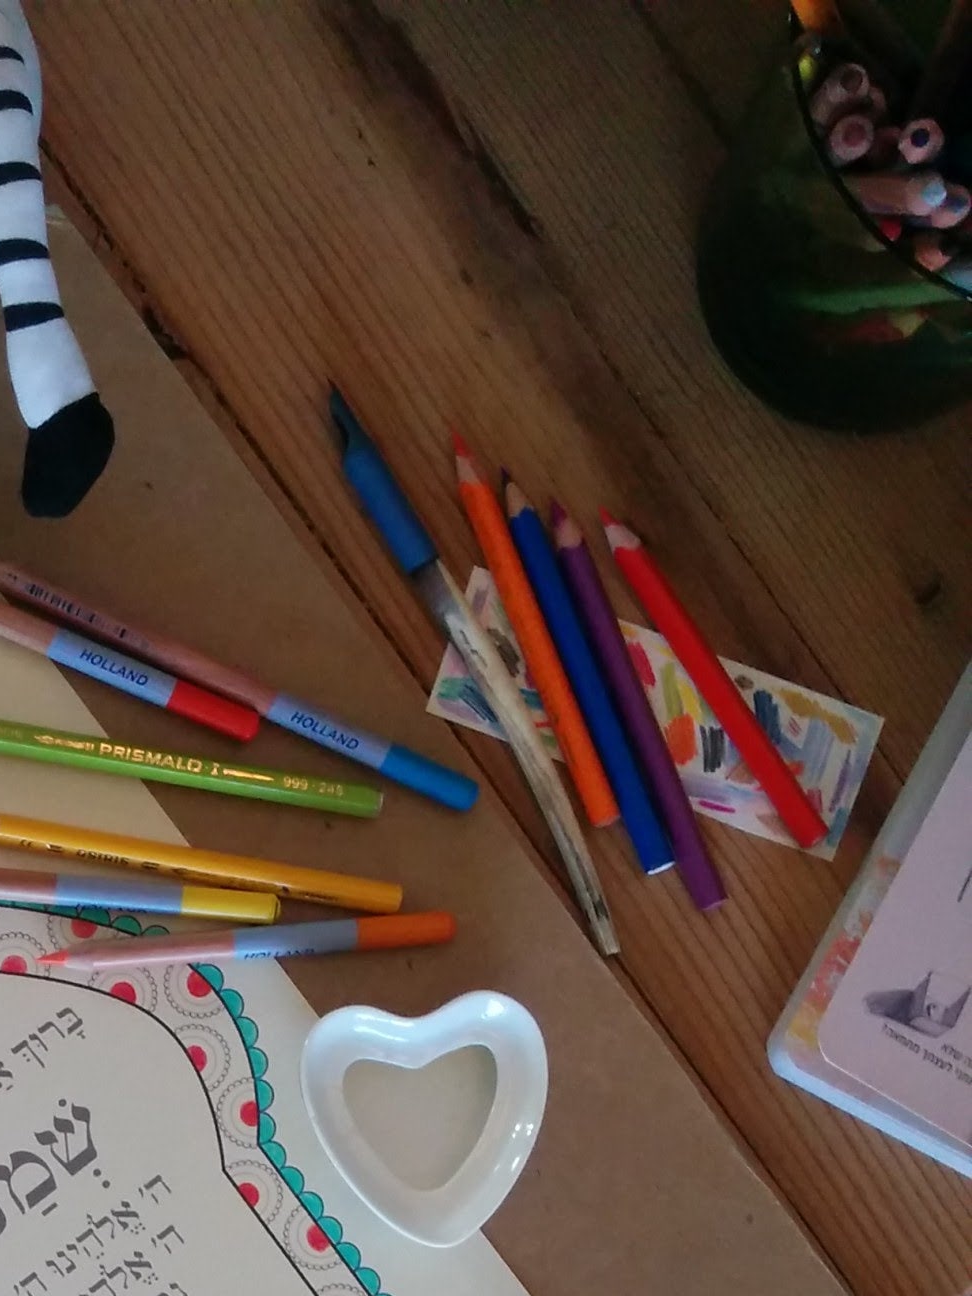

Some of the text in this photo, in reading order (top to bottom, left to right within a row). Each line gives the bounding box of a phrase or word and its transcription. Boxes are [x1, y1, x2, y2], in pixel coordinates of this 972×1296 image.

[79, 648, 149, 687] HOLLAND
[290, 710, 359, 750] HOLLAND
[99, 742, 202, 773] PRISMALO
